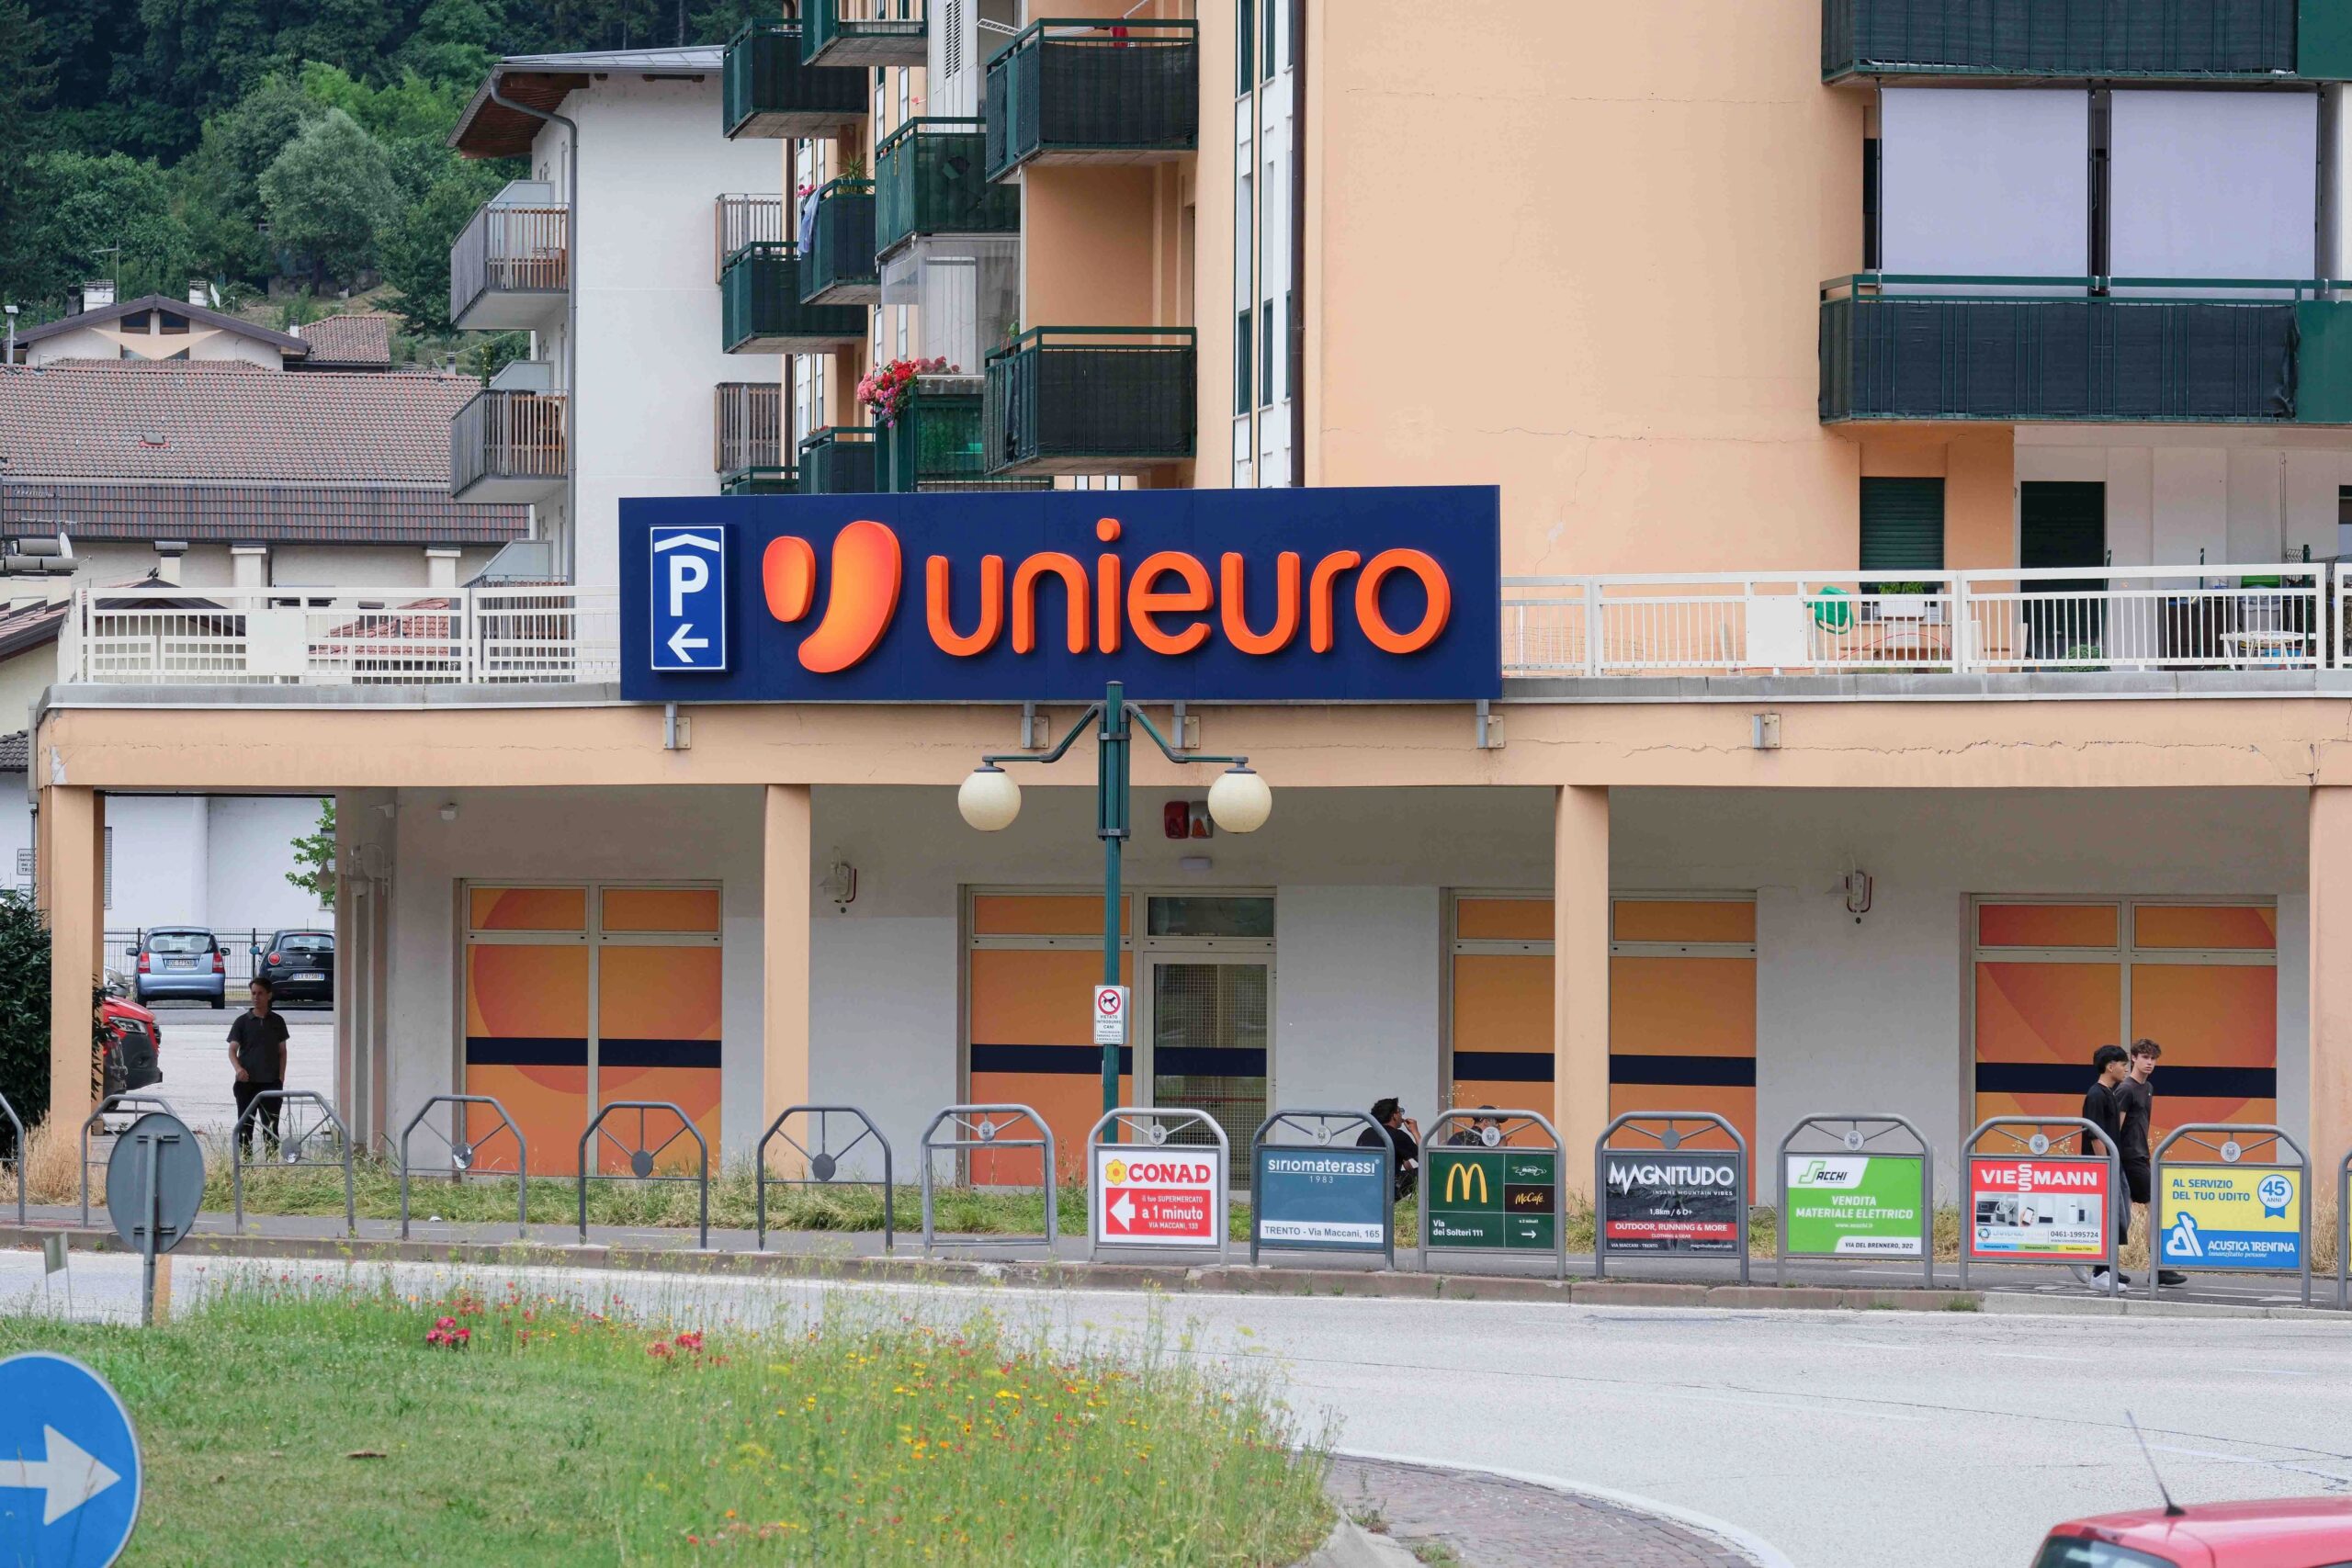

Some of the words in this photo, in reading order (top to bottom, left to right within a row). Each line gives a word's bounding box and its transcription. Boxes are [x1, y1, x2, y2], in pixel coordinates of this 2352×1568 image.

[670, 555, 709, 617] P
[926, 518, 1450, 657] unieuro
[1129, 1164, 1211, 1183] CONAD
[1608, 1161, 1735, 1195] MAGNITUDO
[1981, 1164, 2098, 1191] VIESSMANN
[2173, 1179, 2185, 1187] AL
[2188, 1179, 2233, 1189] SERVIZIO
[2262, 1180, 2285, 1196] 45
[1515, 1192, 1544, 1205] McCafé
[1832, 1196, 1876, 1205] VENDITA
[2173, 1191, 2190, 1200] DEL
[2194, 1191, 2215, 1201] TUO
[2219, 1192, 2250, 1201] UDITO
[1142, 1209, 1149, 1218] a
[1153, 1205, 1158, 1218] 1
[1162, 1206, 1203, 1220] minuto
[1795, 1208, 1853, 1218] MATERIALE
[1856, 1209, 1913, 1219] ELETTRICO
[1265, 1225, 1300, 1235] TRENTO
[1325, 1229, 1362, 1238] Maccani,
[2208, 1240, 2249, 1251] ACUSTICA
[2251, 1242, 2295, 1252] TRENTINA
